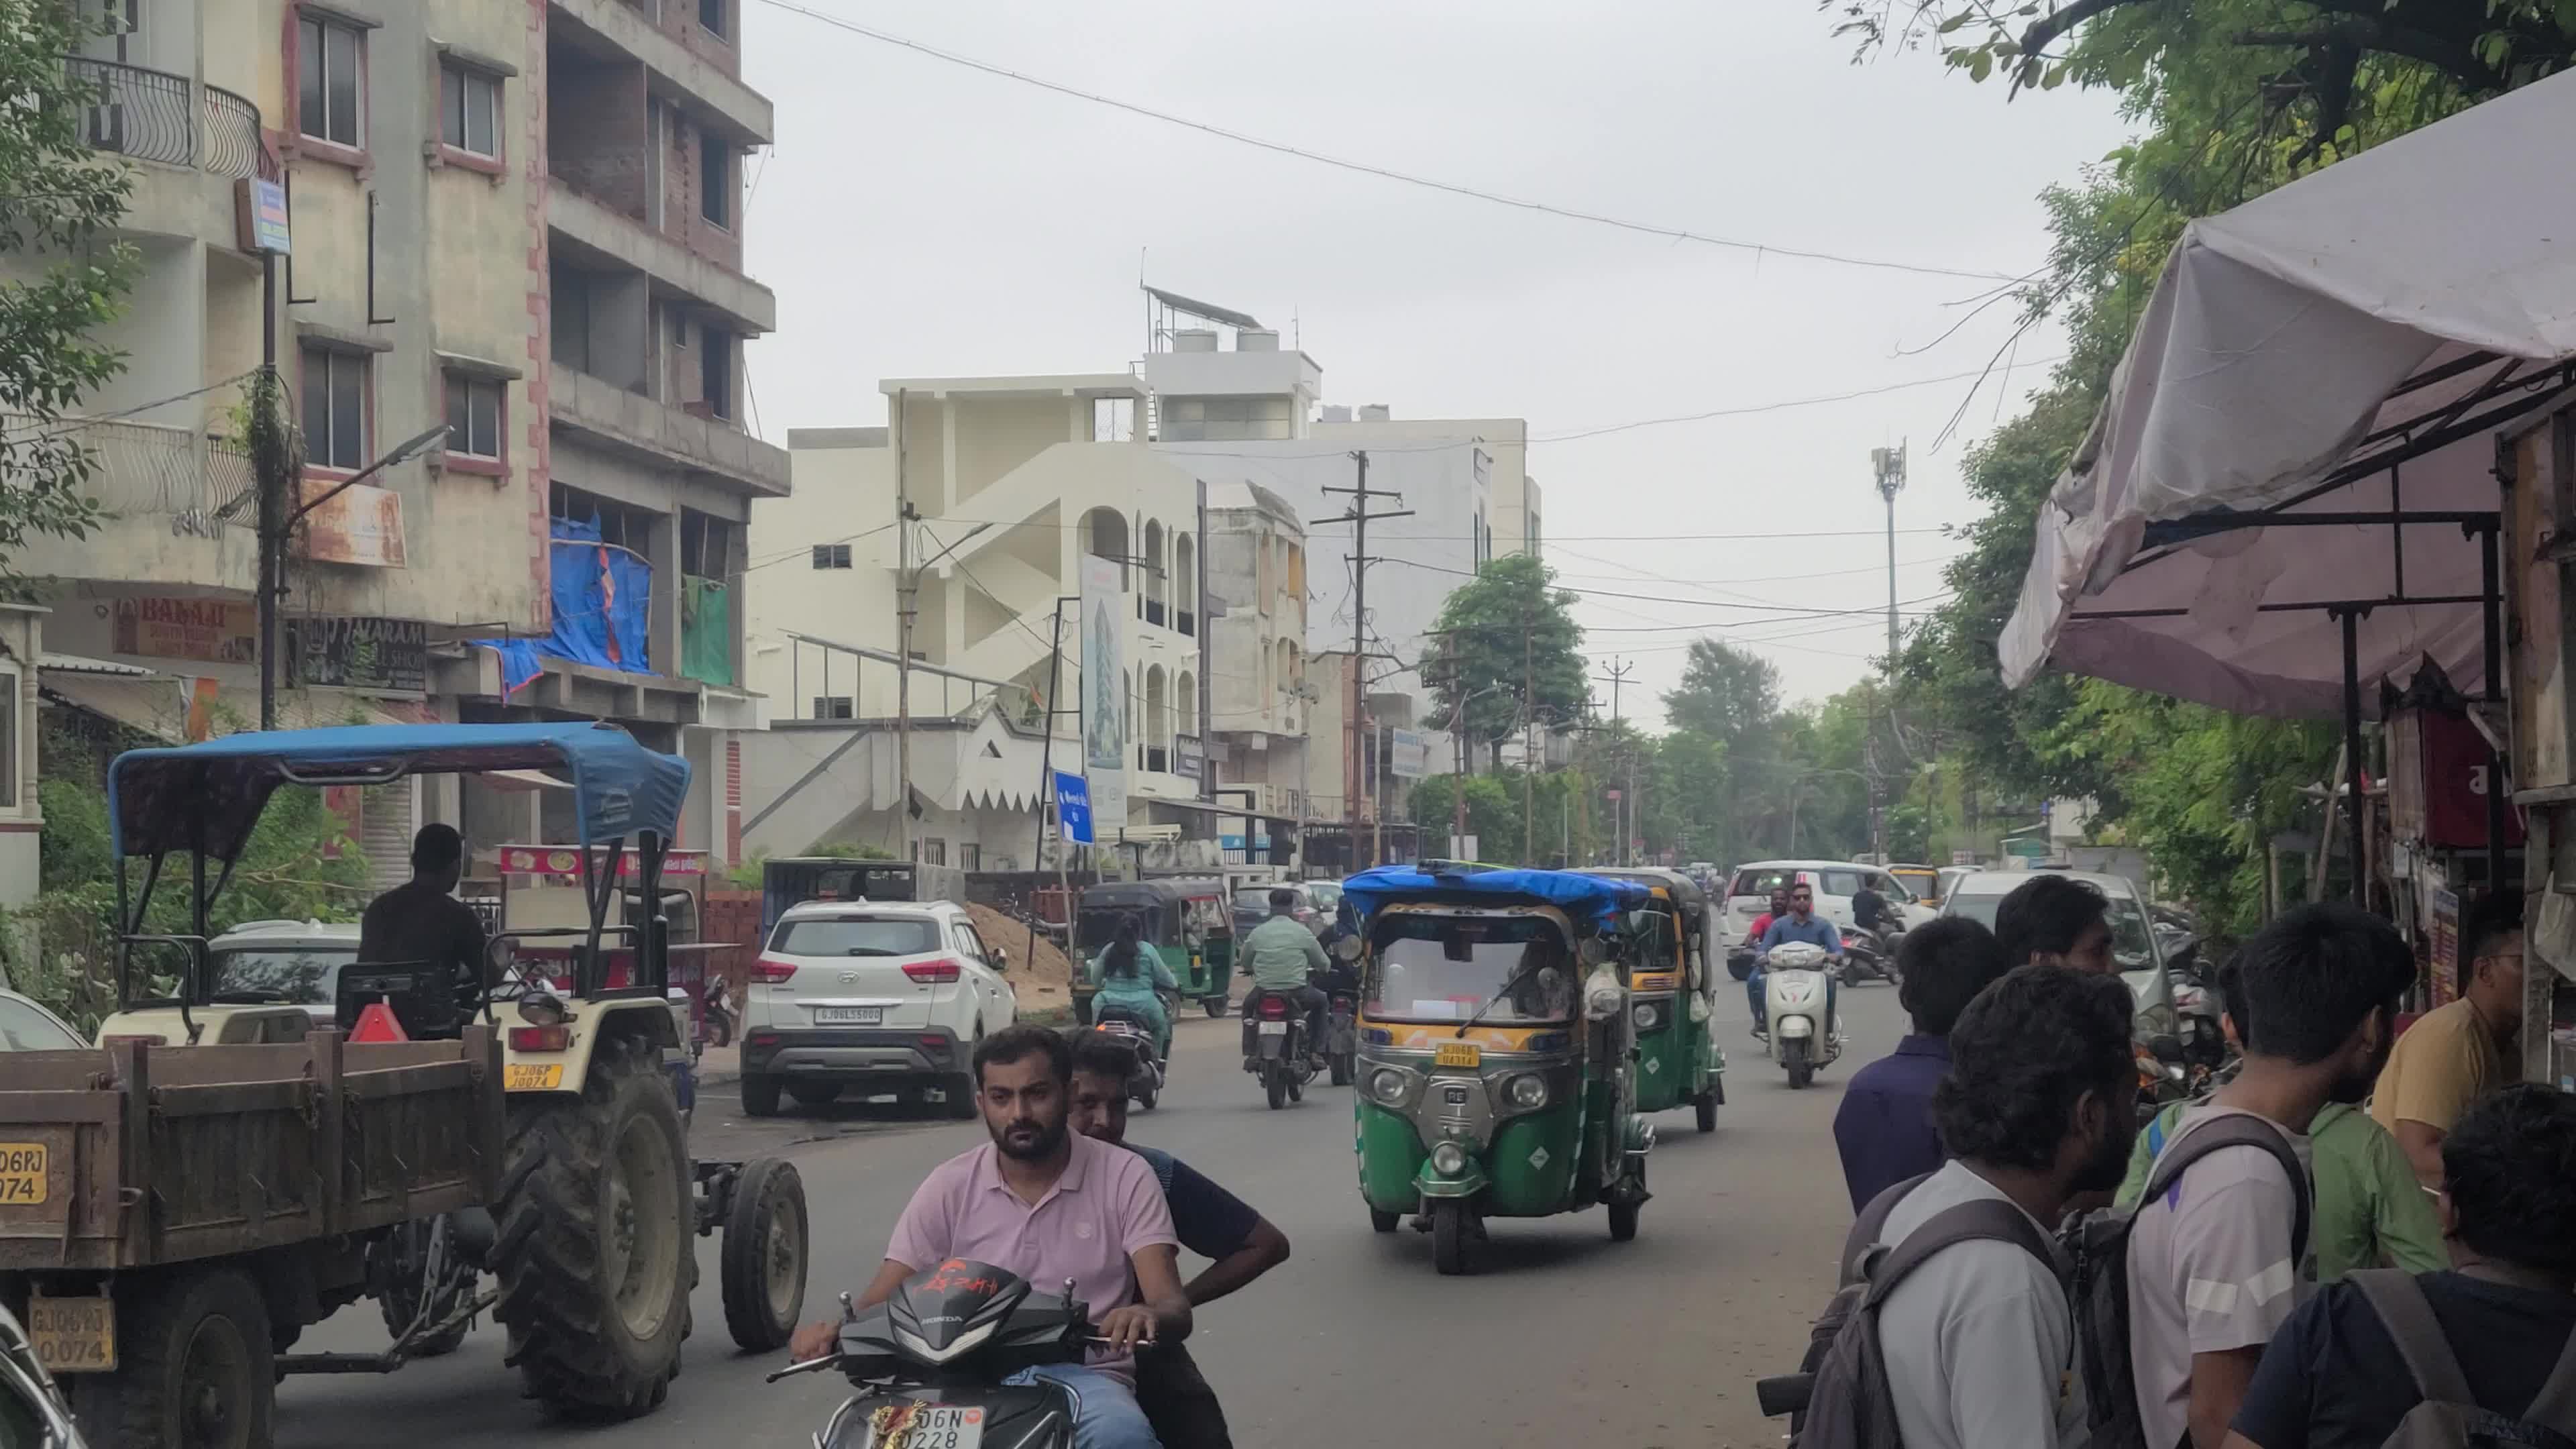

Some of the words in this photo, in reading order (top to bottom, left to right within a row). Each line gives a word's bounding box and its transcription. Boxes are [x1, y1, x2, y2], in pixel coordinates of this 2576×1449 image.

[142, 598, 225, 628] BALAJI
[1448, 1091, 1466, 1102] RE
[921, 1316, 963, 1326] HONDA
[40, 1341, 106, 1362] 0074
